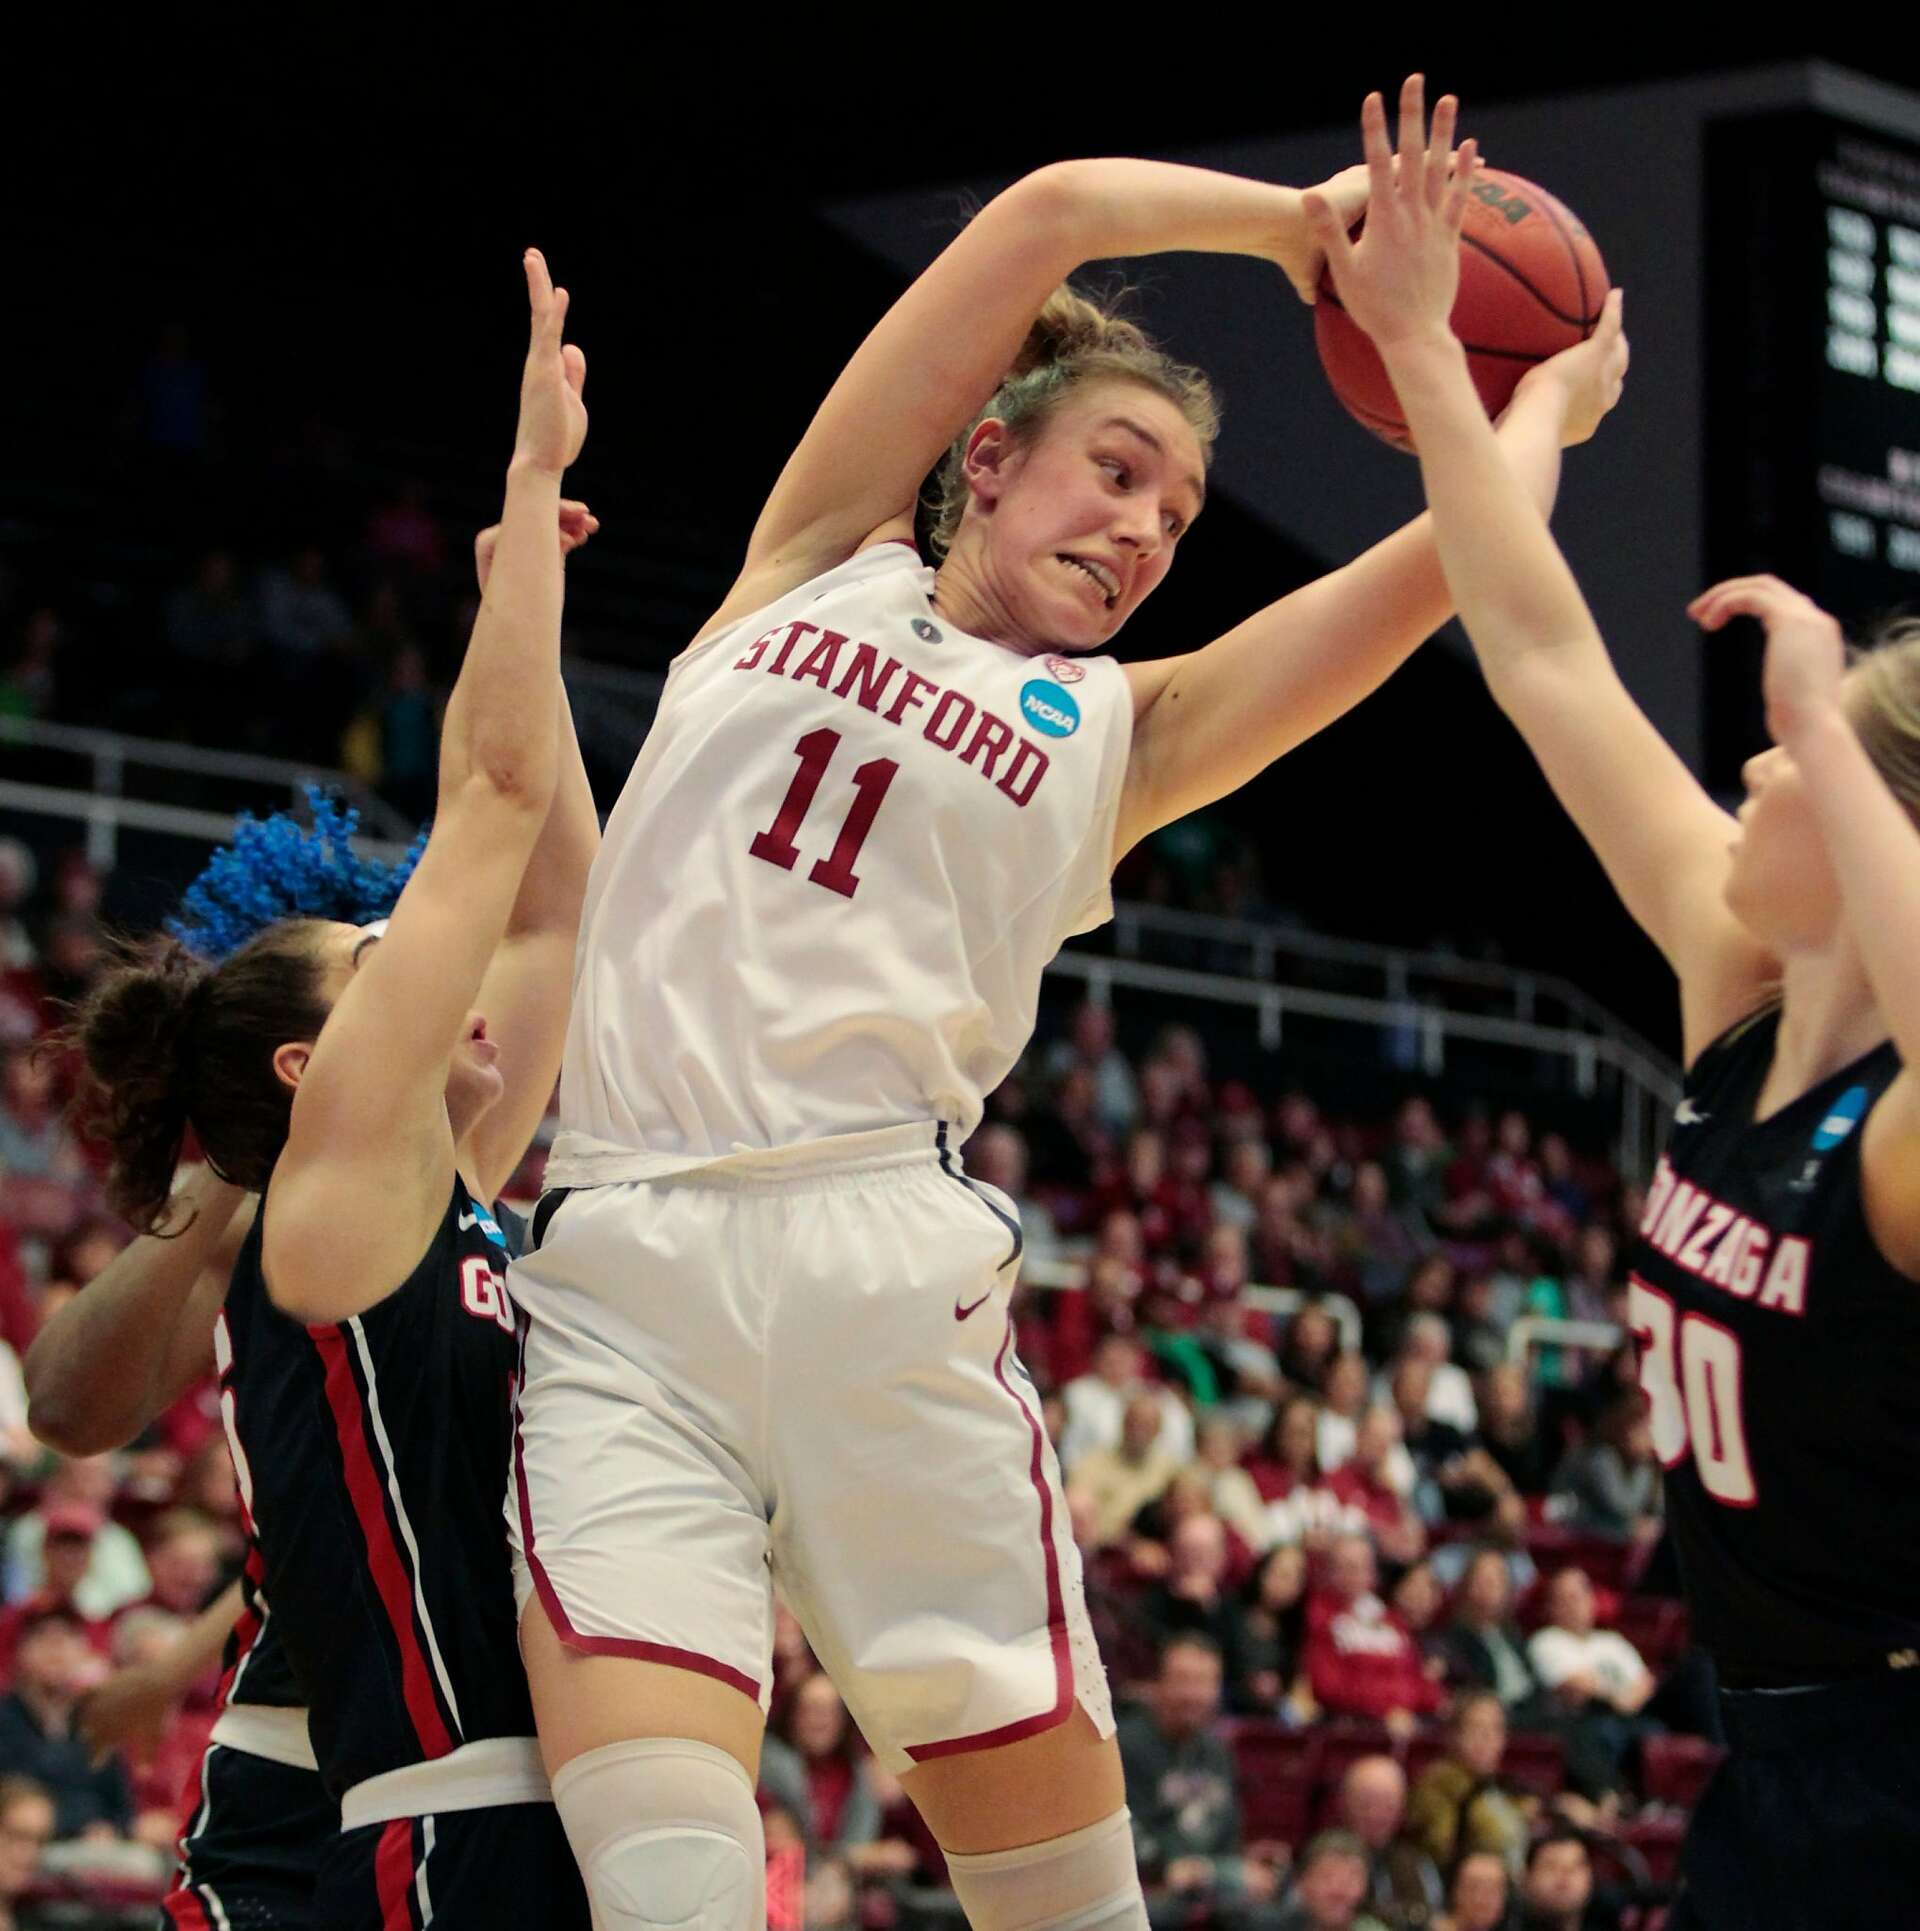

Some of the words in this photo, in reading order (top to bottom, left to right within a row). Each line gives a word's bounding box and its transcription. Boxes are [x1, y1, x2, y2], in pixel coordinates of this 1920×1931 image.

[733, 620, 1050, 808] STANFORD
[1023, 693, 1076, 734] NCAA
[749, 727, 900, 899] 11
